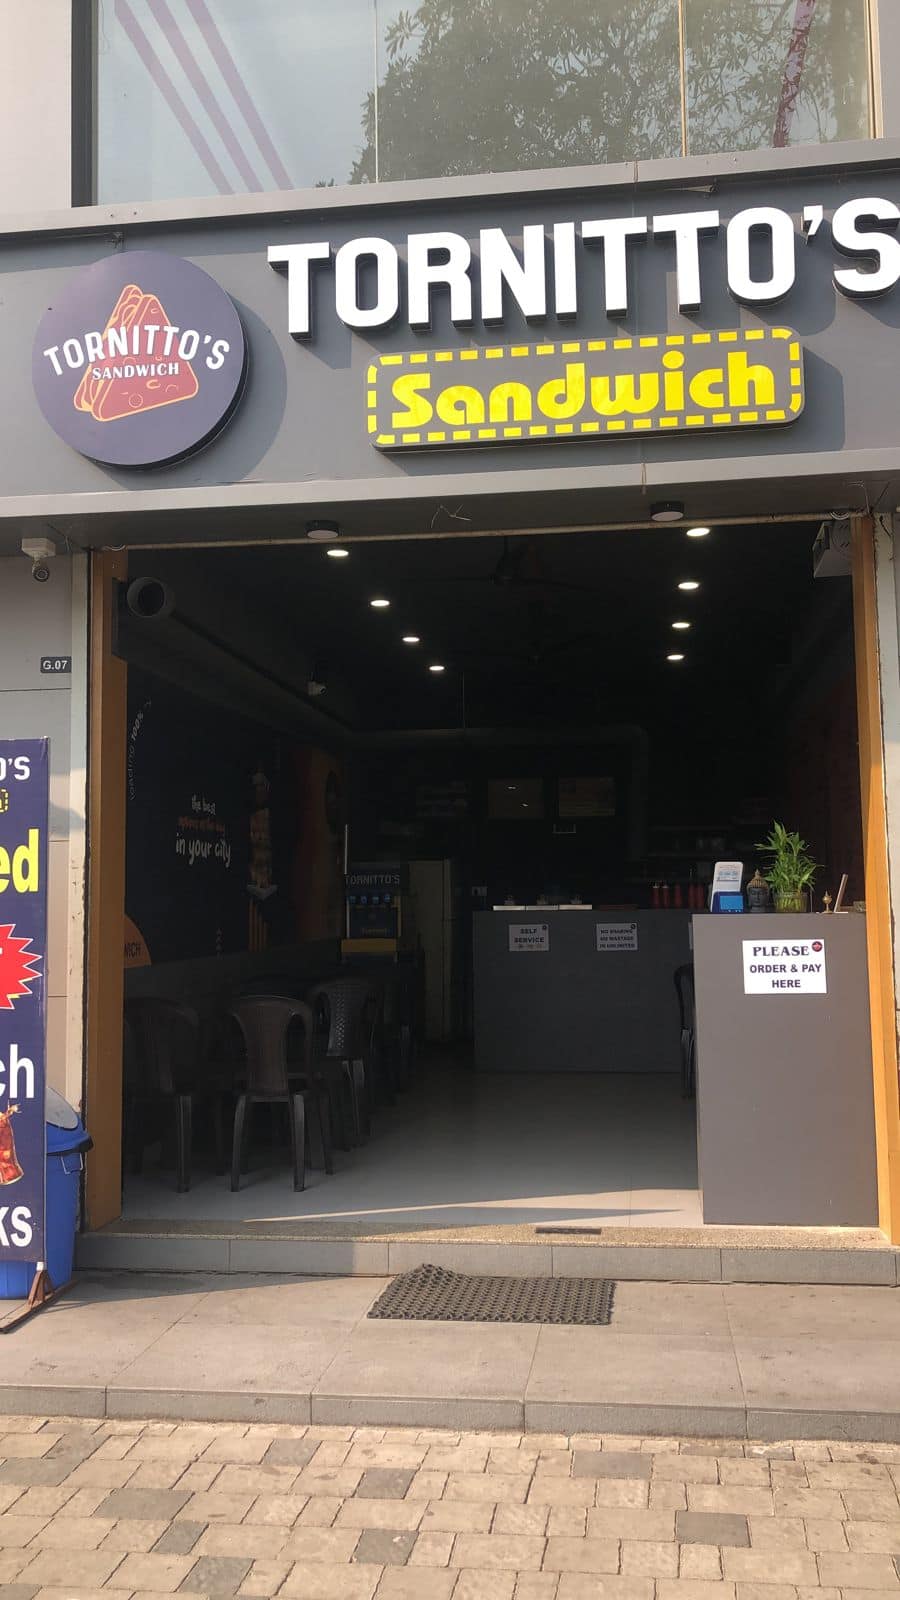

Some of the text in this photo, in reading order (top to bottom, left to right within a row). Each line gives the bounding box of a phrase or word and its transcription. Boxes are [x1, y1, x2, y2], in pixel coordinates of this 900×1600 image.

[267, 198, 900, 335] TORNITTO'S
[43, 324, 230, 376] TORNITTO'S
[92, 362, 179, 380] SANDWICH
[391, 351, 775, 429] Sandwich
[43, 660, 68, 670] G.07
[176, 832, 232, 869] in your city
[752, 946, 809, 957] PLEASE
[749, 963, 822, 973] ORDER & PAY
[771, 979, 801, 988] HERE
[0, 1044, 35, 1099] h
